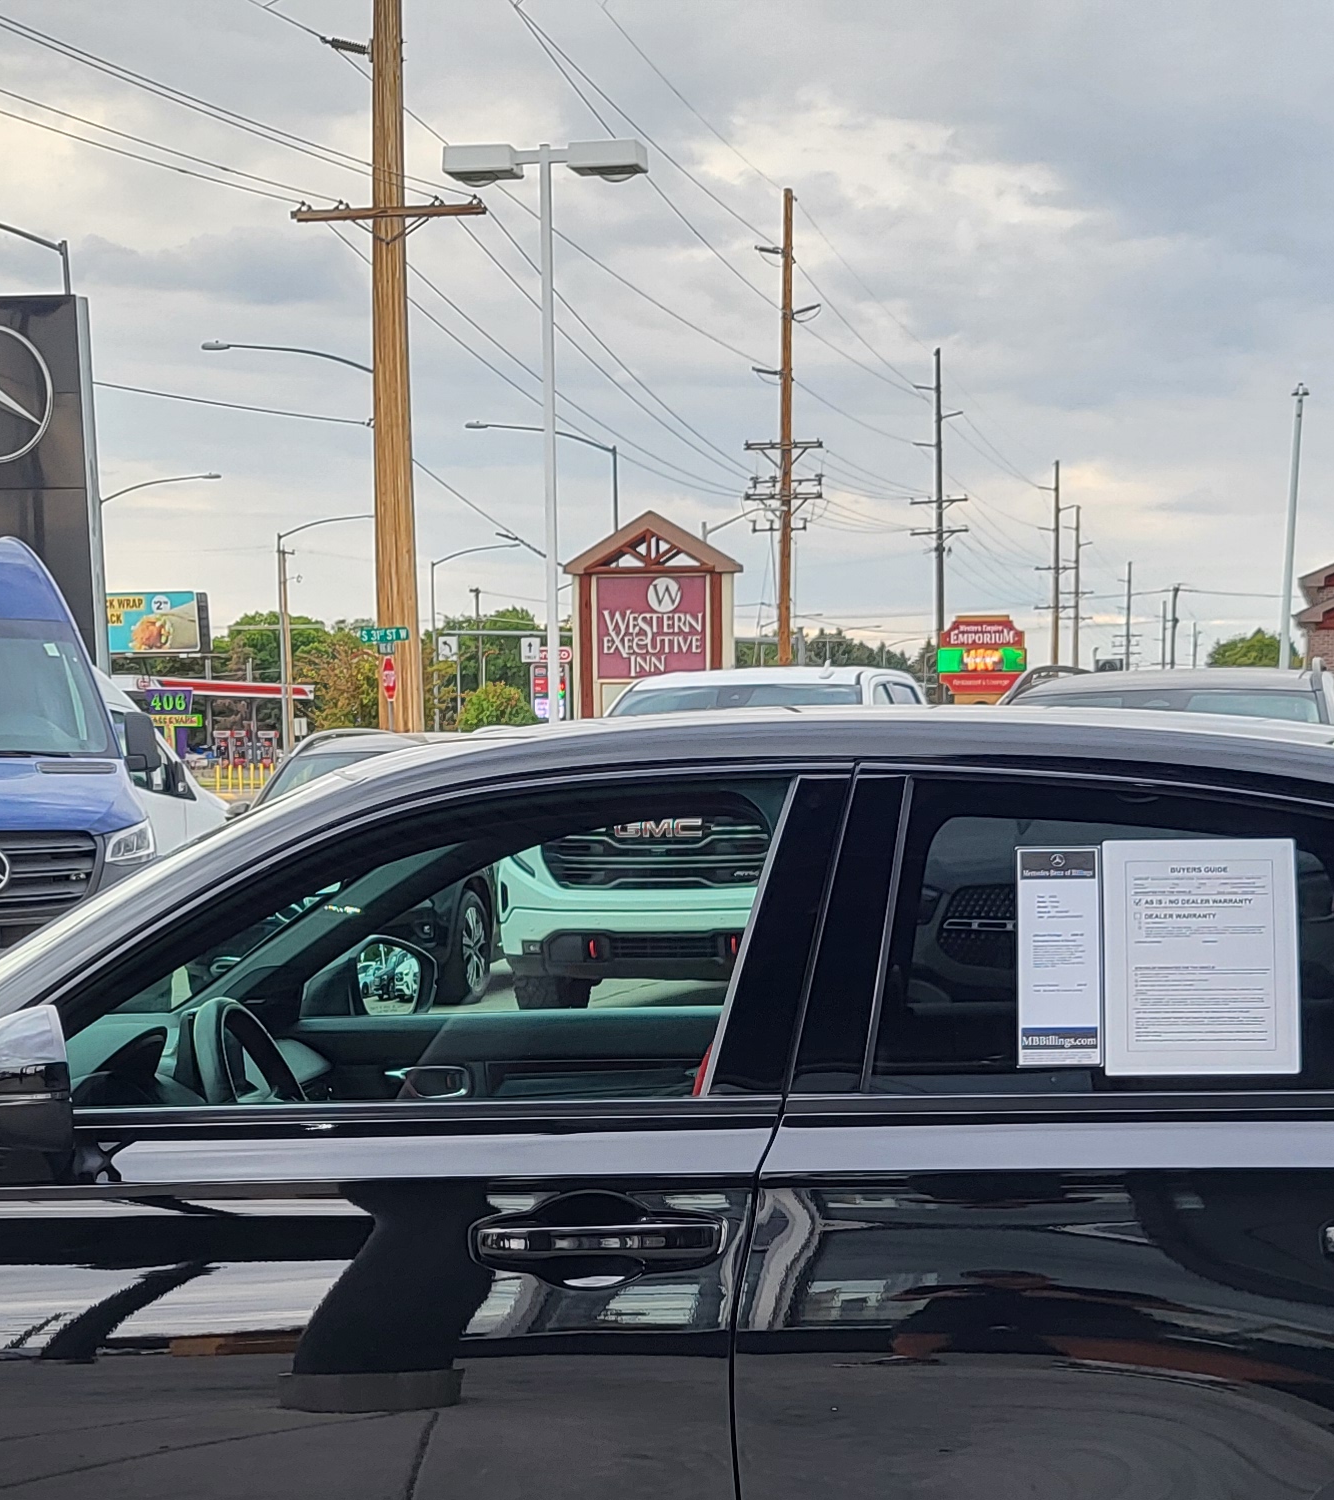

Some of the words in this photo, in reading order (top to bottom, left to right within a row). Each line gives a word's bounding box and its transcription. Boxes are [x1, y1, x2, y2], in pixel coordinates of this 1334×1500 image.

[117, 598, 144, 610] WRAP
[602, 609, 704, 637] WESTERN
[361, 630, 368, 641] S
[386, 629, 396, 640] ST
[399, 629, 407, 639] W
[950, 628, 1015, 644] EMPORIUM
[603, 634, 703, 655] EXECUTIVE
[629, 655, 667, 677] INN
[151, 694, 186, 711] 406
[613, 817, 703, 838] GMC
[1170, 866, 1203, 874] BUYERS
[1144, 898, 1154, 906] AS
[1155, 898, 1163, 906] IS
[1212, 897, 1253, 905] WARRANTY
[1175, 912, 1217, 920] WARRANTY
[1022, 1035, 1097, 1048] MBBillings.com
